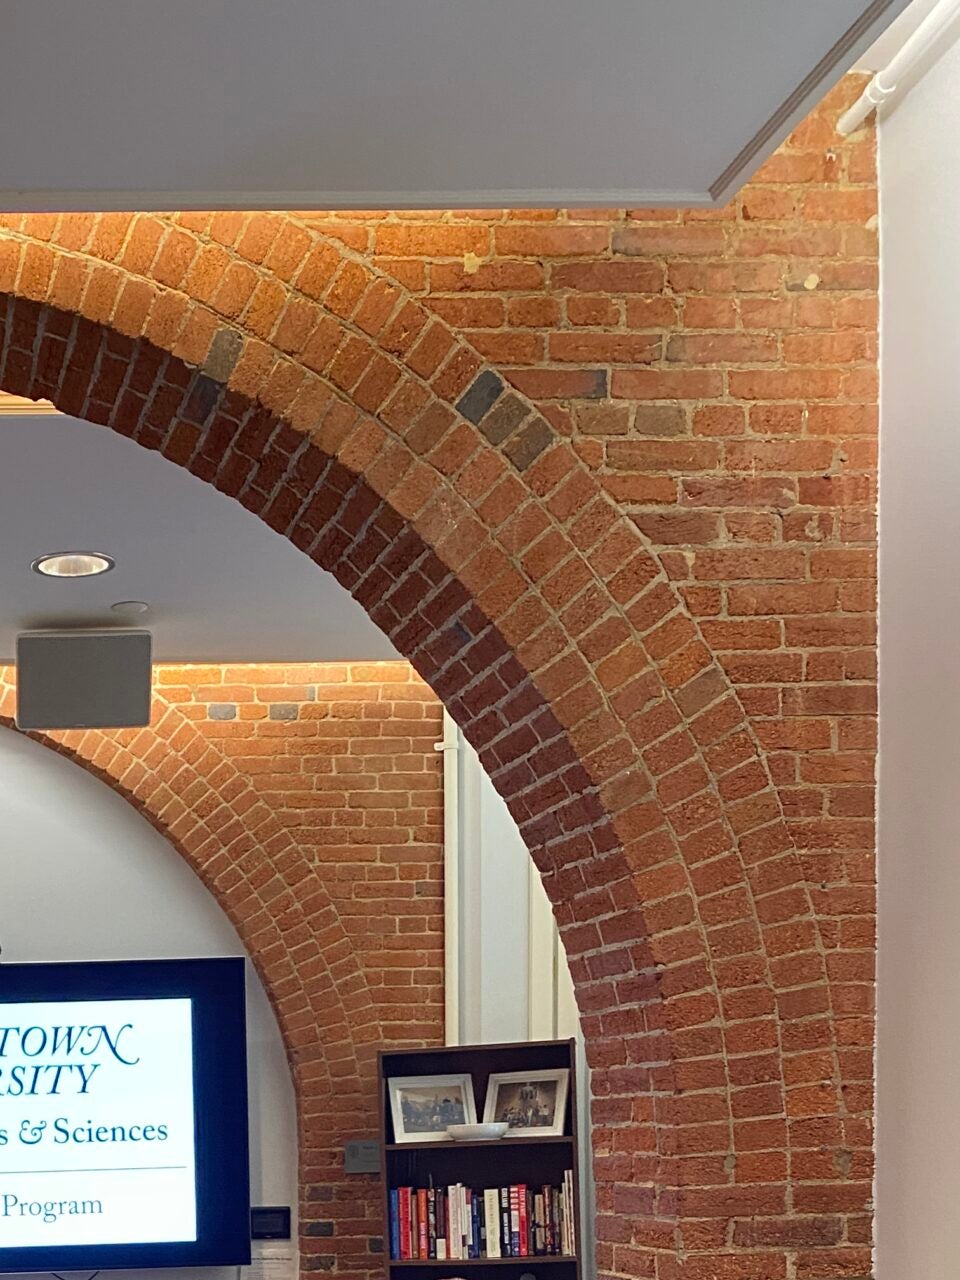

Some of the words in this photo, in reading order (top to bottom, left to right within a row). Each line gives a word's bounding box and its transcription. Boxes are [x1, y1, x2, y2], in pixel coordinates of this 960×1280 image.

[18, 1120, 48, 1145] &
[53, 1118, 169, 1144] Sciences
[0, 1194, 103, 1229] Program
